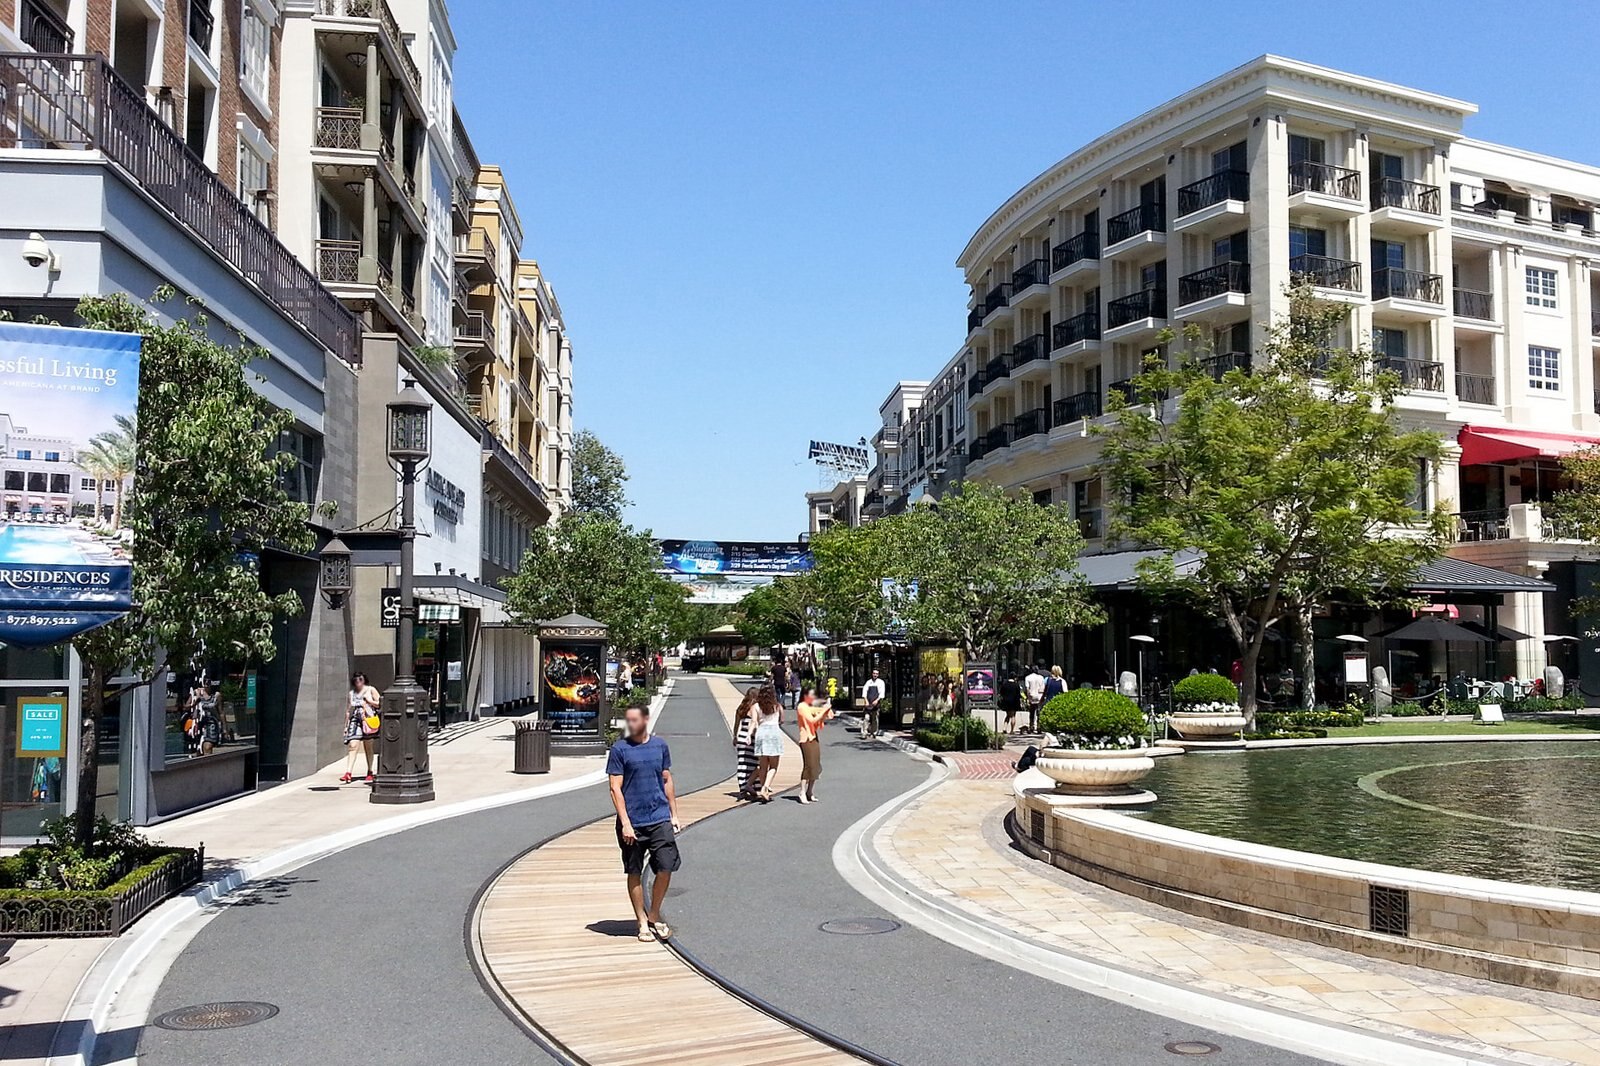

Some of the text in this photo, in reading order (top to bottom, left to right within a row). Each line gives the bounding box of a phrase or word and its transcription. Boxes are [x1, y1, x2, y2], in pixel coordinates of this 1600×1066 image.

[51, 359, 118, 386] Living
[3, 381, 101, 393] AMERICANA AT BRAND
[0, 569, 111, 590] RESIDENCES
[7, 615, 78, 626] 877.897.5222
